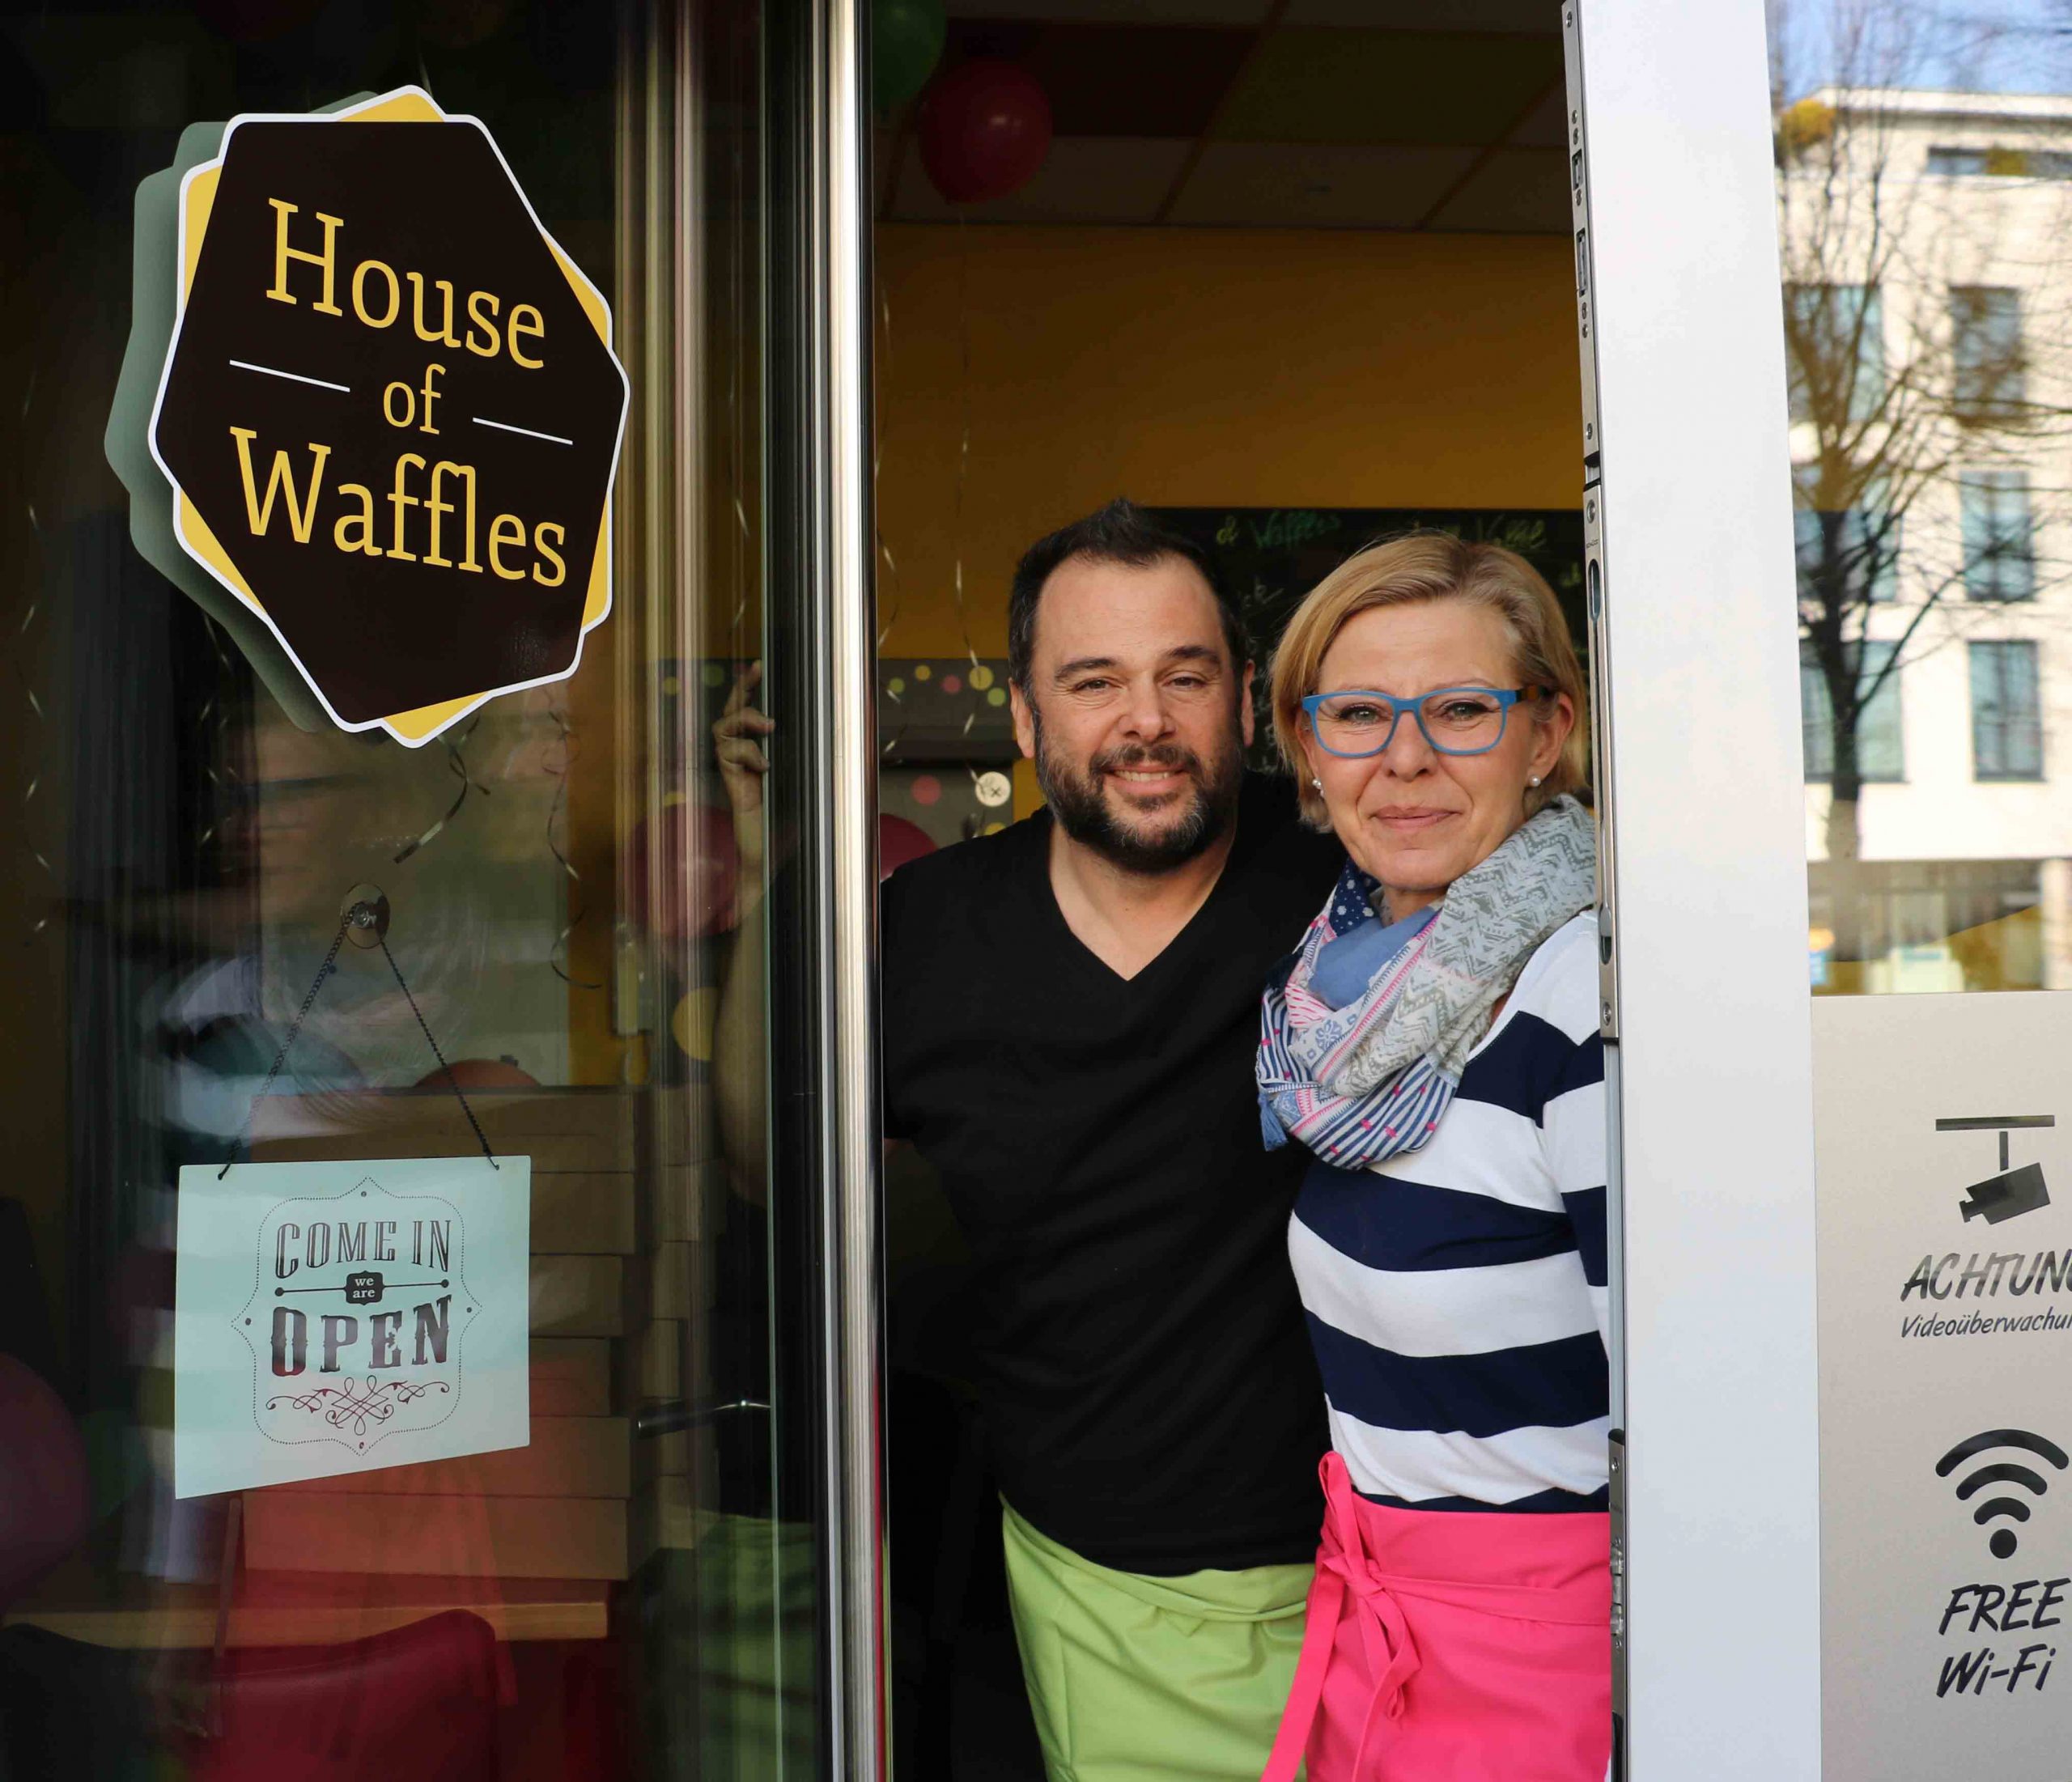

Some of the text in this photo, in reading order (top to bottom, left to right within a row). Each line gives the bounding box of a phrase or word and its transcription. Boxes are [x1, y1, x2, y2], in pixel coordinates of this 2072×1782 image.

[266, 197, 546, 370] House
[383, 363, 446, 435] of
[229, 426, 567, 588] Waffles
[275, 1220, 452, 1279] COME IN
[352, 1289, 376, 1299] are
[354, 1277, 375, 1287] we
[270, 1295, 452, 1377] OPEN
[1938, 1577, 2072, 1636] FREE
[1936, 1643, 2057, 1699] Wi-Fi
